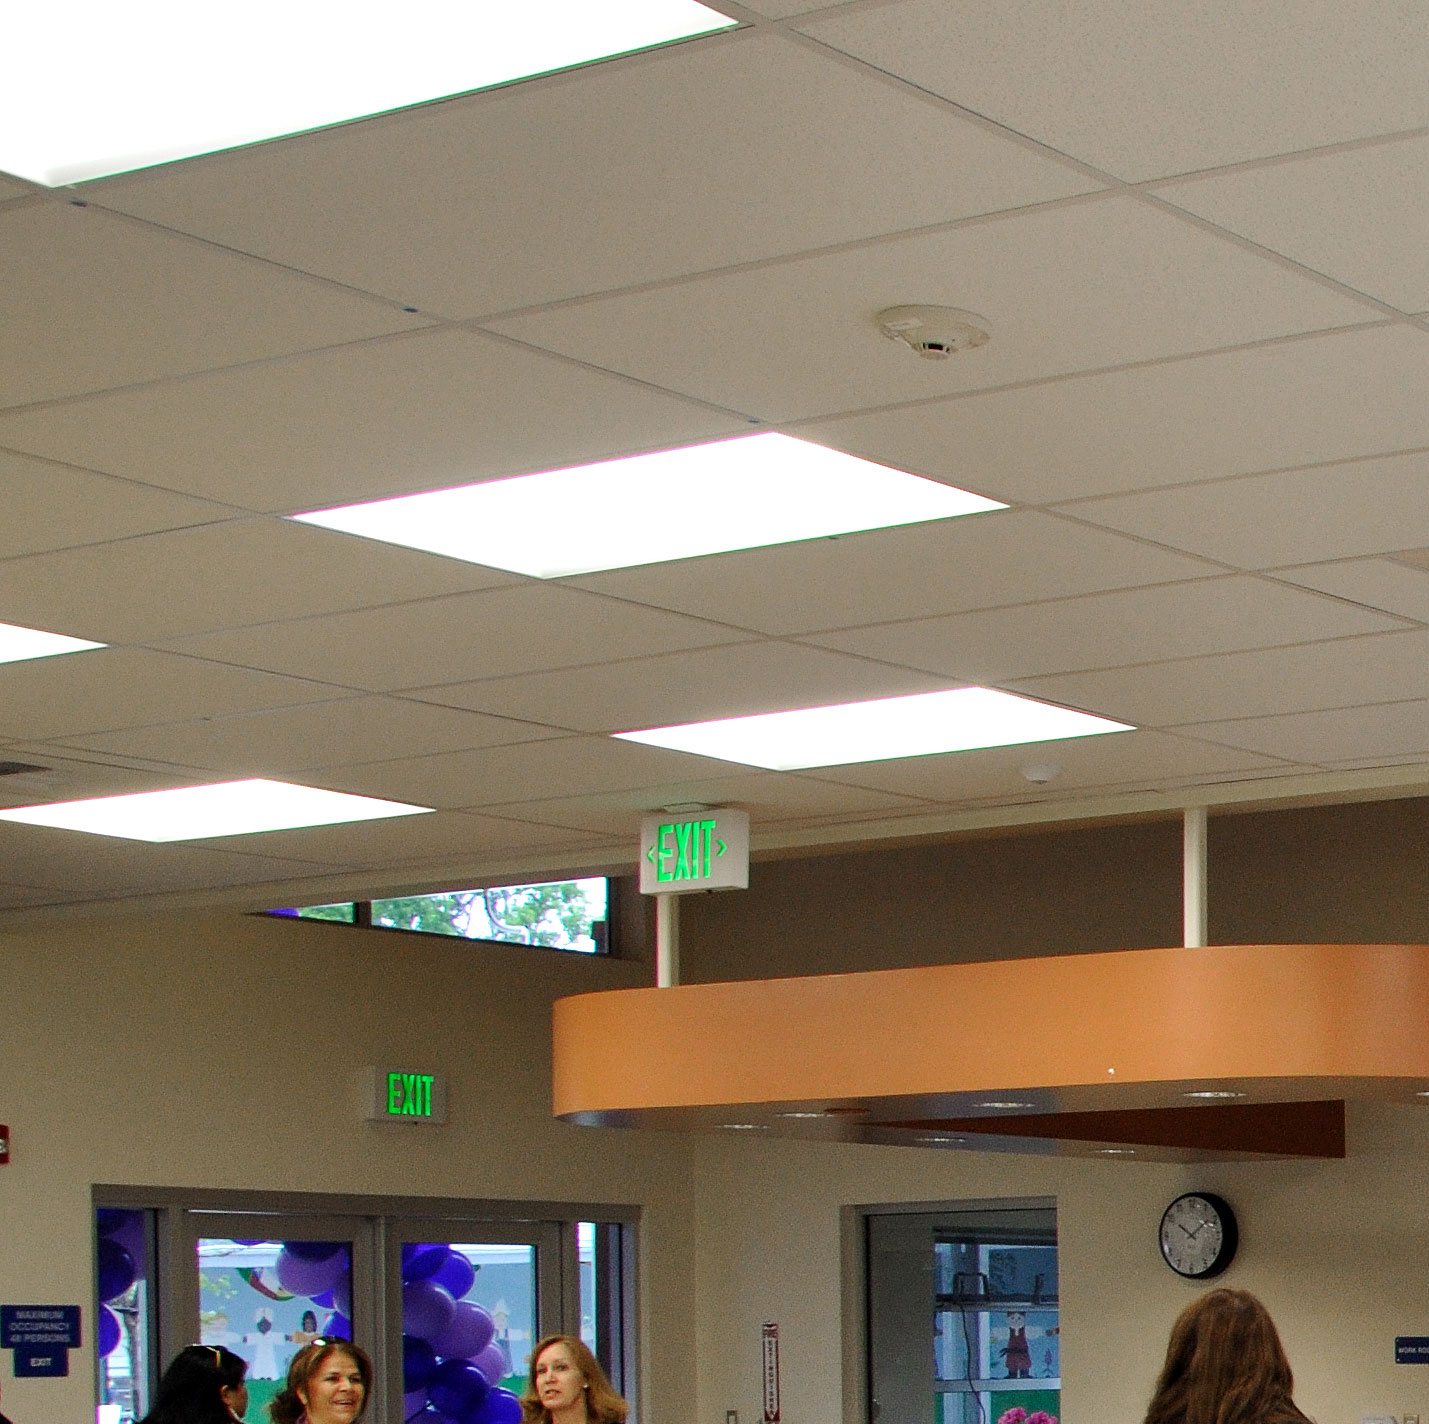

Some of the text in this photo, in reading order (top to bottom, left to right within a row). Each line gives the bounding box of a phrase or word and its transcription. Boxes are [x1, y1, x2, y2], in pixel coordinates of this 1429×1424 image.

[657, 820, 716, 882] EXIT
[387, 1072, 434, 1117] EXIT
[30, 1358, 51, 1367] EXIT
